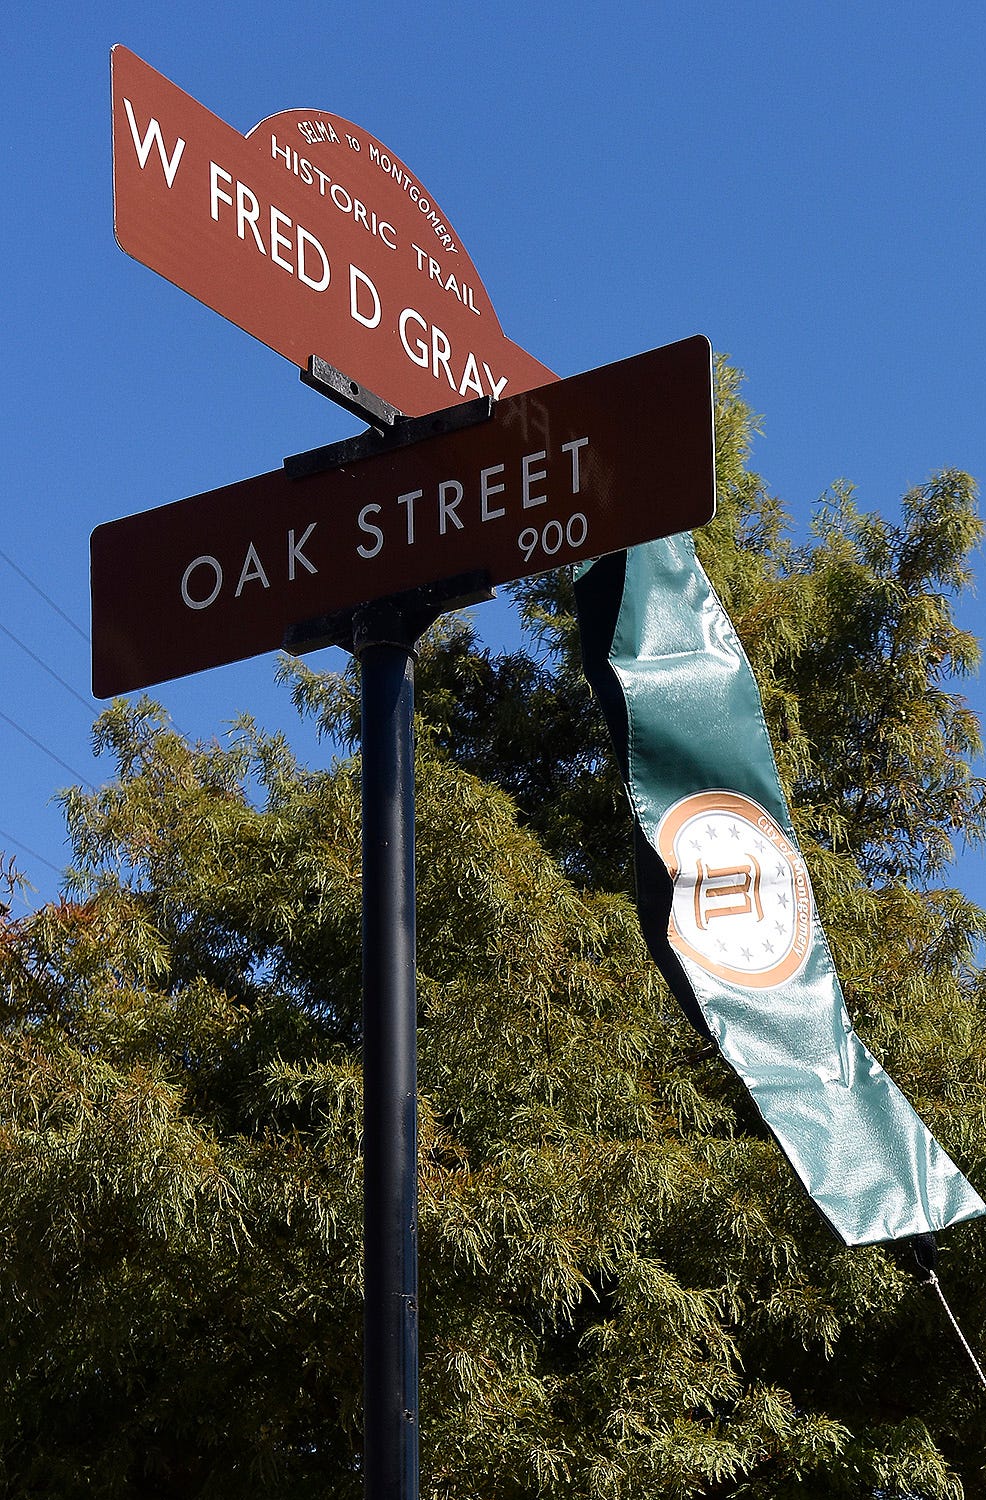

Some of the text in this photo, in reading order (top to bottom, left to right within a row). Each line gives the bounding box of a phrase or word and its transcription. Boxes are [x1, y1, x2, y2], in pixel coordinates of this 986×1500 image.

[124, 98, 508, 402] W FRED D GRAY
[271, 135, 481, 316] HISTORIC TRAIL
[298, 121, 458, 253] SELMA TO MONTGOMERY
[182, 437, 588, 609] OAK STREET
[518, 513, 588, 562] 900
[757, 815, 810, 958] City of Montgomery
